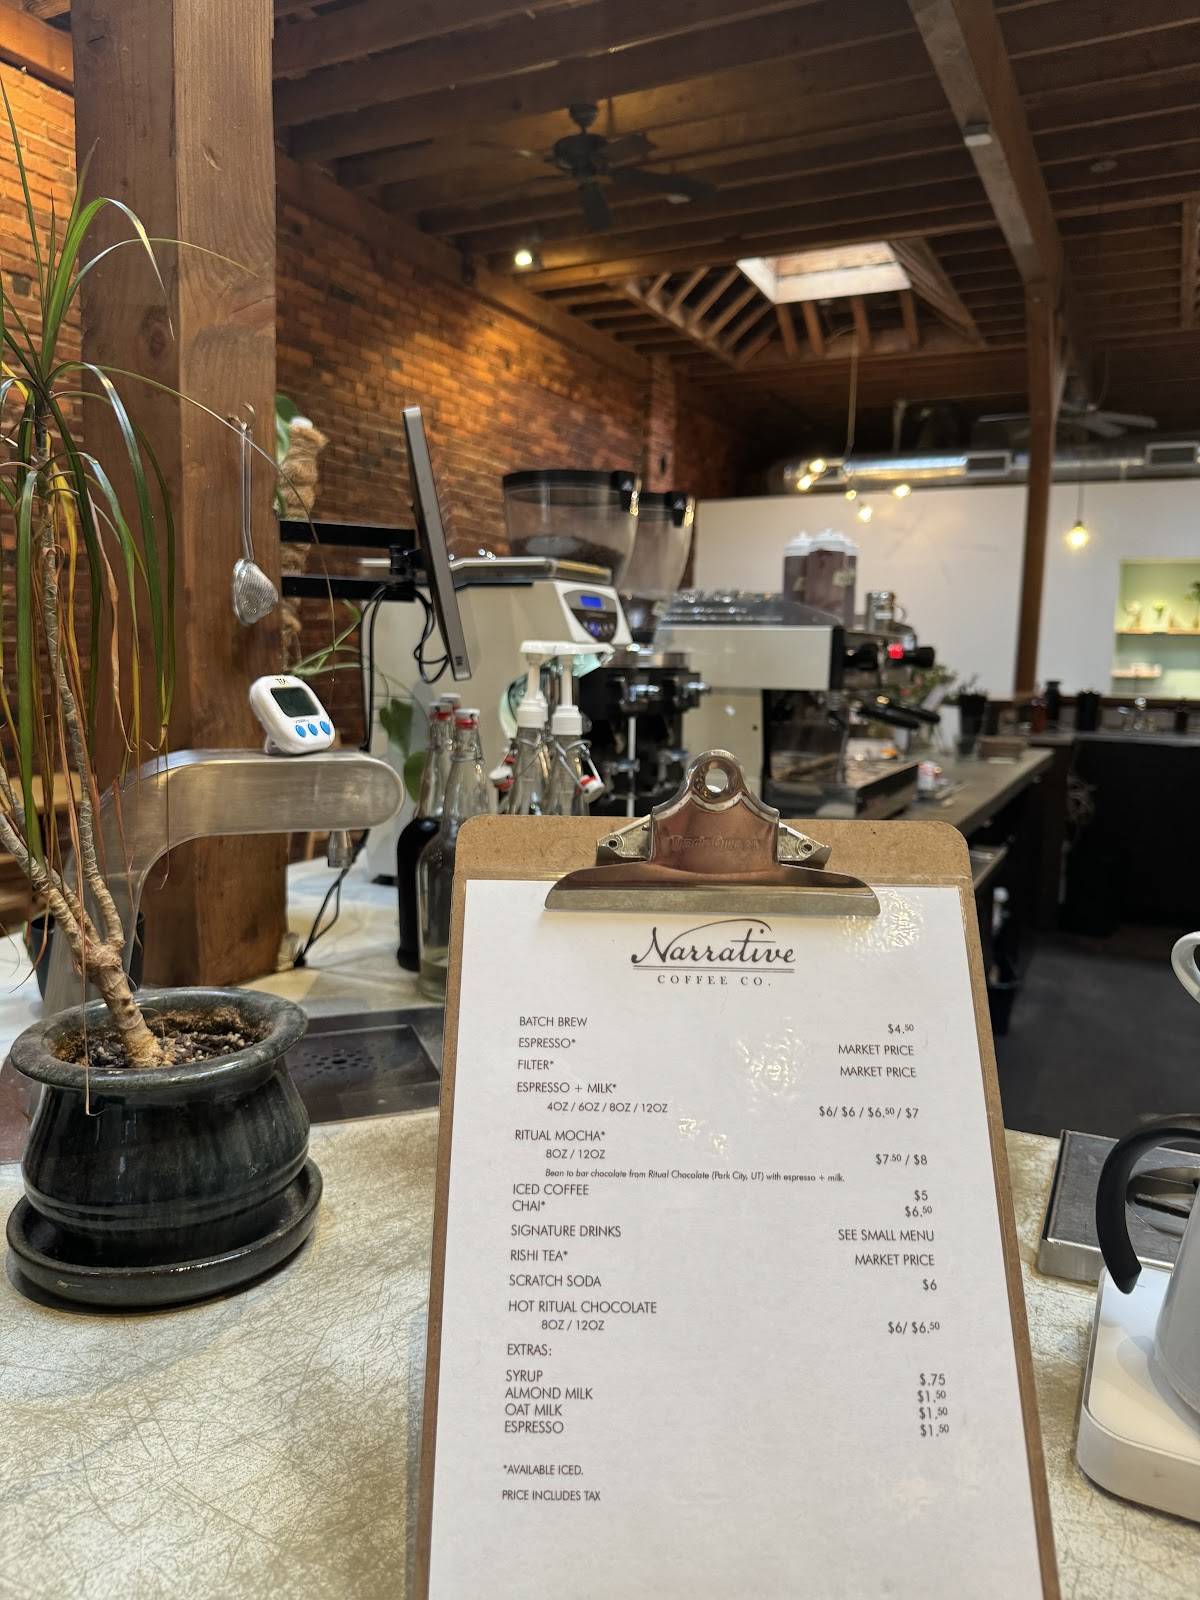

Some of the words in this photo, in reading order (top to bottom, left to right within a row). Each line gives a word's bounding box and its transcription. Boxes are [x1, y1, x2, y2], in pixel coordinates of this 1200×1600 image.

[631, 917, 797, 964] Narrative
[658, 975, 727, 985] COFFEE
[741, 977, 770, 986] CO.
[520, 1016, 554, 1027] BATCH
[558, 1017, 587, 1027] BREW
[888, 1024, 914, 1034] $4.50
[838, 1044, 880, 1056] MARKET
[884, 1045, 914, 1056] PRICE
[840, 1066, 883, 1078] MARKET
[886, 1067, 917, 1078] PRICE
[516, 1081, 570, 1094] ESPRESSO
[575, 1084, 582, 1093] +
[547, 1102, 568, 1112] 4OZ
[571, 1102, 576, 1112] /
[577, 1102, 600, 1112] 6OZ
[602, 1103, 607, 1112] /
[610, 1103, 631, 1112] 8OZ
[633, 1103, 638, 1113] /
[642, 1103, 668, 1113] 12OZ
[842, 1106, 855, 1118] $6
[859, 1107, 864, 1118] /
[868, 1106, 895, 1119] $6.50
[897, 1108, 901, 1119] /
[905, 1107, 919, 1119] $7
[515, 1129, 551, 1141] RITUAL
[546, 1148, 568, 1160] 8OZ
[570, 1149, 575, 1159] /
[578, 1149, 605, 1160] 12OZ
[905, 1154, 910, 1166] /
[914, 1154, 927, 1166] $8
[545, 1168, 564, 1177] Bean
[576, 1168, 589, 1177] bar
[590, 1168, 627, 1178] chocolate
[629, 1169, 646, 1179] from
[648, 1170, 669, 1179] Ritual
[671, 1170, 709, 1179] Chocolate
[712, 1171, 730, 1181] (Park
[732, 1171, 748, 1182] City,
[751, 1172, 764, 1182] UT)
[766, 1172, 781, 1181] with
[828, 1173, 845, 1182] milk.
[513, 1183, 540, 1195] ICED
[543, 1184, 589, 1196] COFFEE
[914, 1190, 928, 1202] $5
[905, 1206, 932, 1218] $6.50
[511, 1224, 575, 1237] SIGNATURE
[580, 1225, 621, 1238] DRINKS
[838, 1229, 857, 1241] SEE
[861, 1229, 896, 1241] SMALL
[900, 1230, 934, 1242] MENU
[511, 1249, 538, 1262] RISHI
[855, 1254, 899, 1266] MARKET
[903, 1254, 935, 1266] PRICE
[509, 1274, 562, 1287] SCRATCH
[567, 1274, 602, 1287] SODA
[923, 1278, 937, 1291] $6
[509, 1300, 535, 1312] HOT
[539, 1300, 578, 1313] RITUAL
[581, 1301, 657, 1314] CHOCOLATE
[541, 1319, 564, 1330] 8OZ
[567, 1320, 572, 1331] /
[577, 1320, 605, 1331] 12OZ
[912, 1321, 940, 1335] $6.50
[507, 1343, 552, 1357] EXTRAS:
[506, 1369, 543, 1382] SYRUP
[920, 1373, 945, 1386] $.75
[505, 1386, 561, 1400] ALMOND
[565, 1387, 593, 1400] MILK
[917, 1390, 946, 1404] $1.50
[505, 1403, 530, 1416] OAT
[534, 1404, 562, 1416] MILK
[919, 1407, 948, 1420] $1.50
[505, 1420, 564, 1434] ESPRESSO
[920, 1424, 949, 1438] $1.50
[558, 1465, 583, 1476] ICED.
[502, 1490, 529, 1500] PRICE
[532, 1490, 581, 1501] INCLUDES
[584, 1490, 600, 1502] TAX
